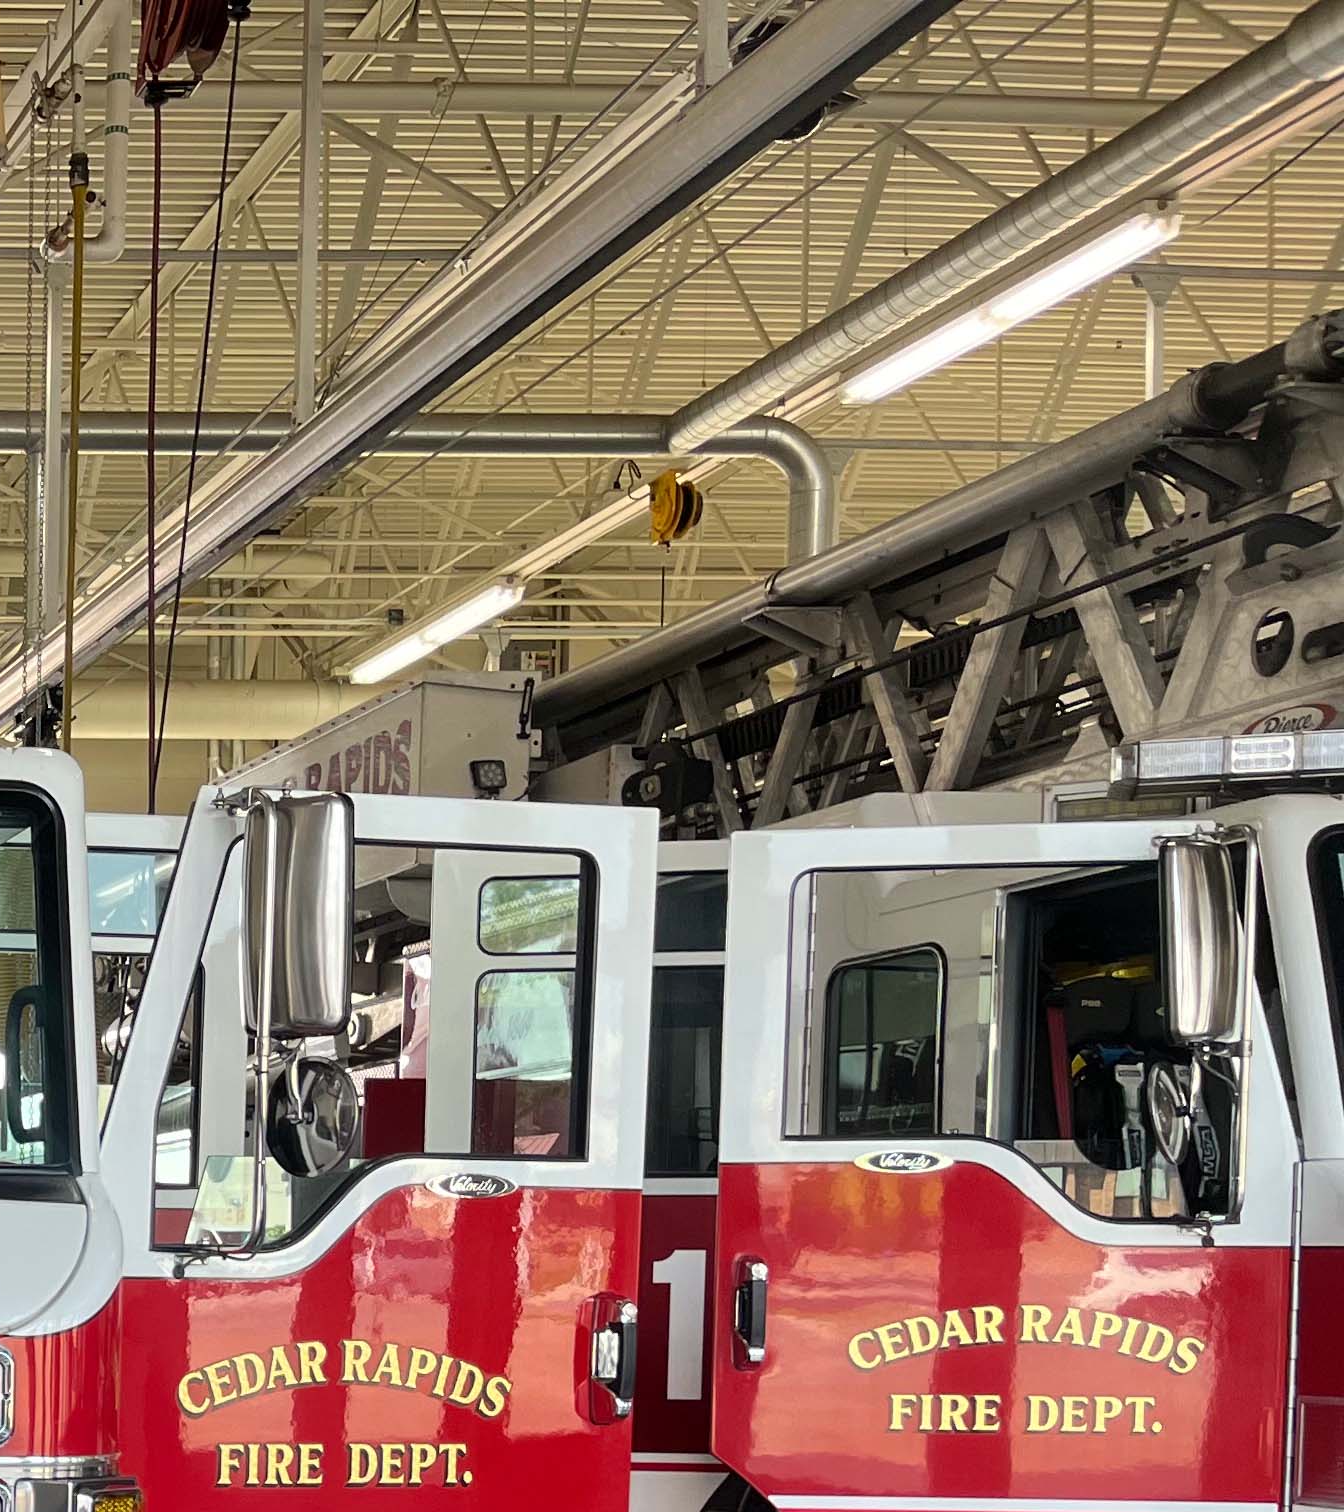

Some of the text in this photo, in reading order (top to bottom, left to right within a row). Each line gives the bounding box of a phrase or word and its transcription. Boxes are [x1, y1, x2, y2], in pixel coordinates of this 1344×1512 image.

[1263, 714, 1312, 734] Pierce
[879, 1152, 931, 1170] Velocity
[449, 1176, 498, 1195] Velocity
[652, 1249, 707, 1400] 1
[847, 1303, 1205, 1376] CEDAR RAPIDS
[176, 1338, 512, 1421] CEDAR RAPIDS
[888, 1393, 1164, 1435] FIRE DEPT.
[215, 1442, 473, 1488] FIRE DEPT.
